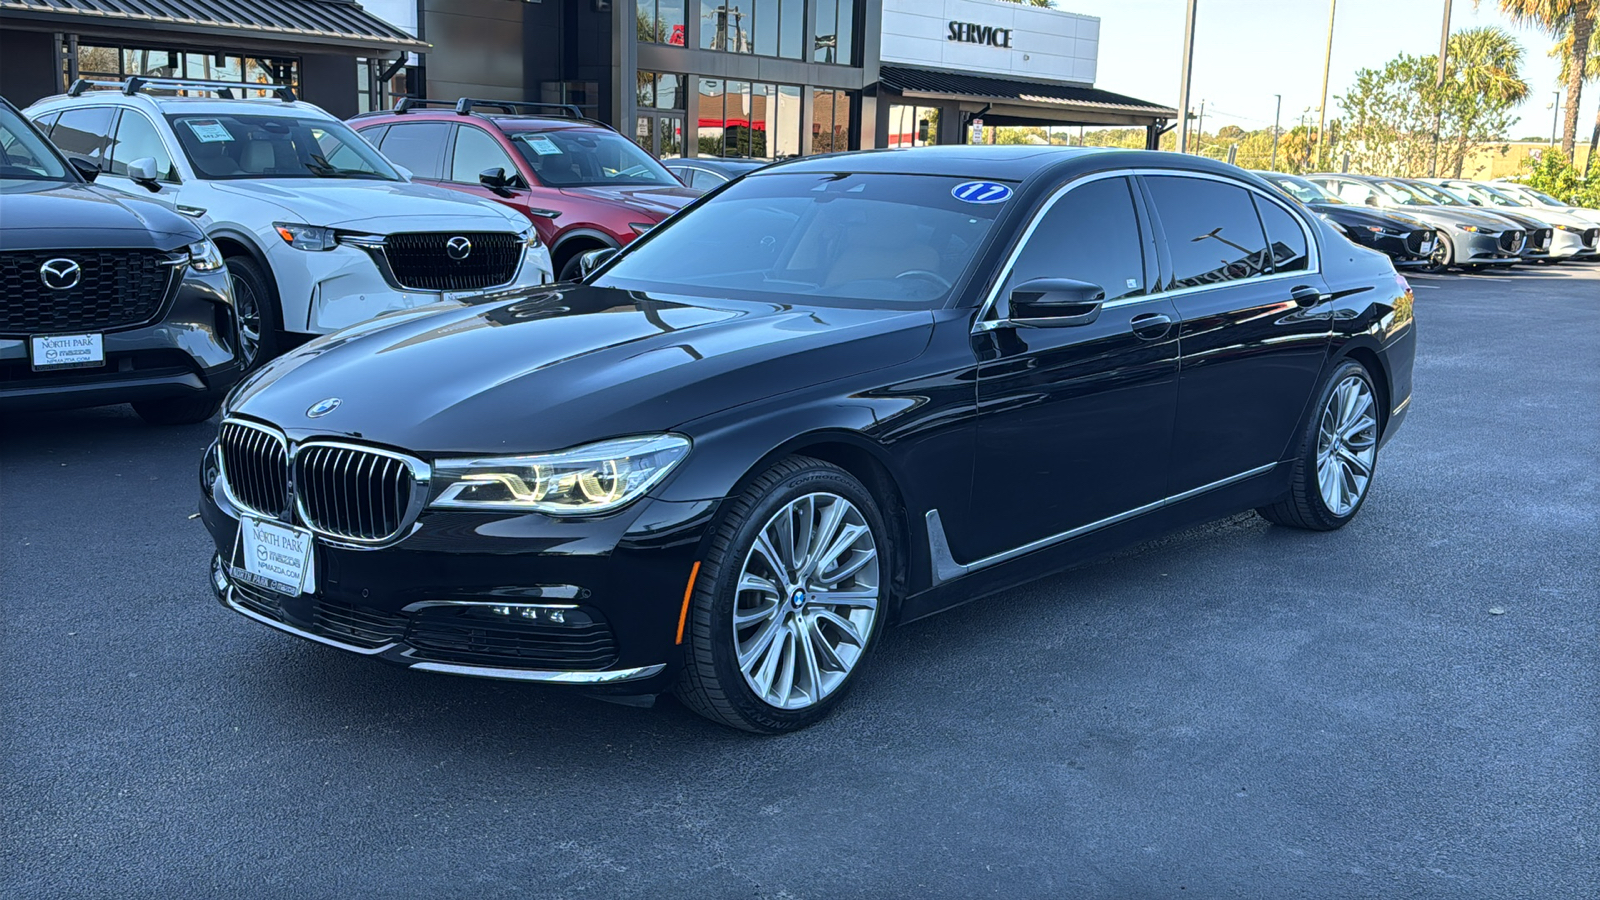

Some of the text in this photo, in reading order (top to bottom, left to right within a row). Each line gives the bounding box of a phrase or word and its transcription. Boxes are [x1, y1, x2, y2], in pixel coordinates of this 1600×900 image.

[947, 20, 1013, 48] SERVICE
[960, 183, 1005, 200] 17
[42, 338, 93, 349] NORTH PARK
[252, 528, 303, 553] NORTH PARK
[269, 551, 300, 568] mazda
[258, 561, 300, 579] NPMAZDA.COM
